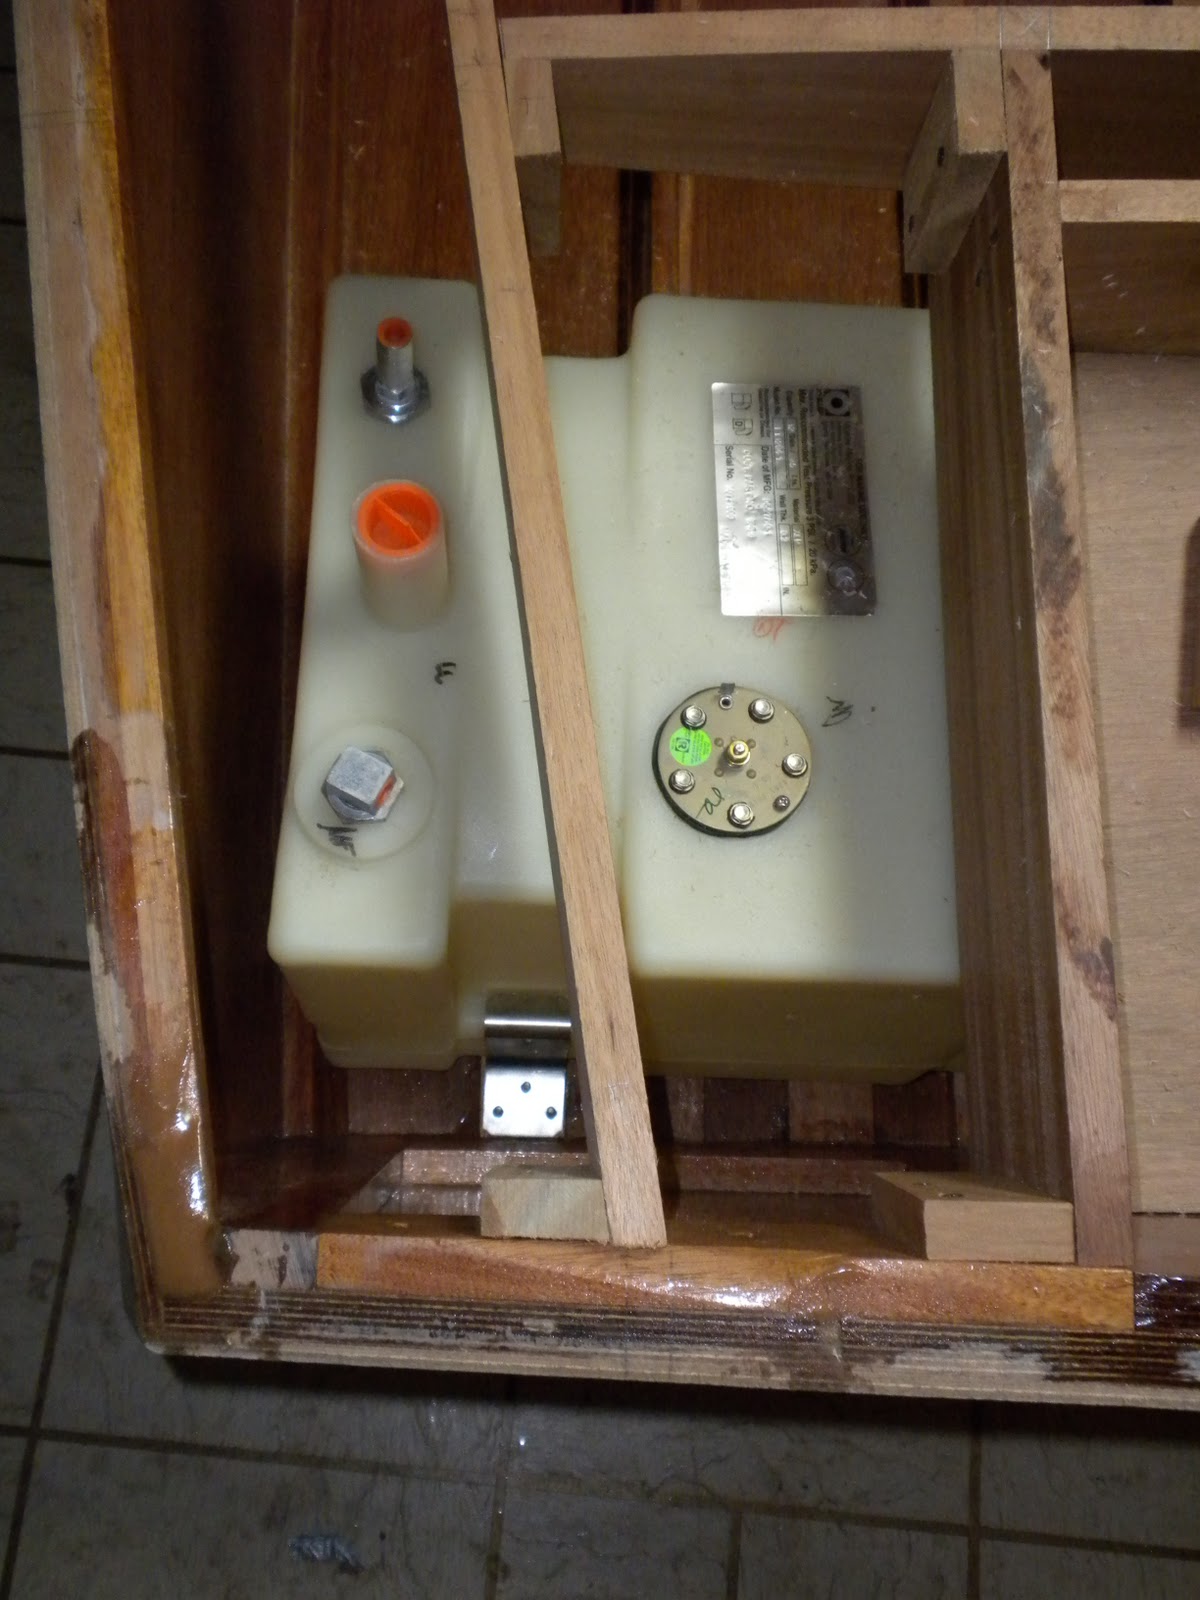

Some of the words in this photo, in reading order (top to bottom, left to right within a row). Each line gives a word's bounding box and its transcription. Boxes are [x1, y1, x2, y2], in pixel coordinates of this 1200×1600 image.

[800, 408, 812, 463] Recommended
[725, 446, 734, 466] Serial
[761, 446, 771, 462] Date
[726, 468, 735, 480] No.
[762, 464, 771, 473] of
[763, 474, 772, 494] MFG:
[804, 482, 814, 515] Pressure
[809, 548, 818, 557] 20
